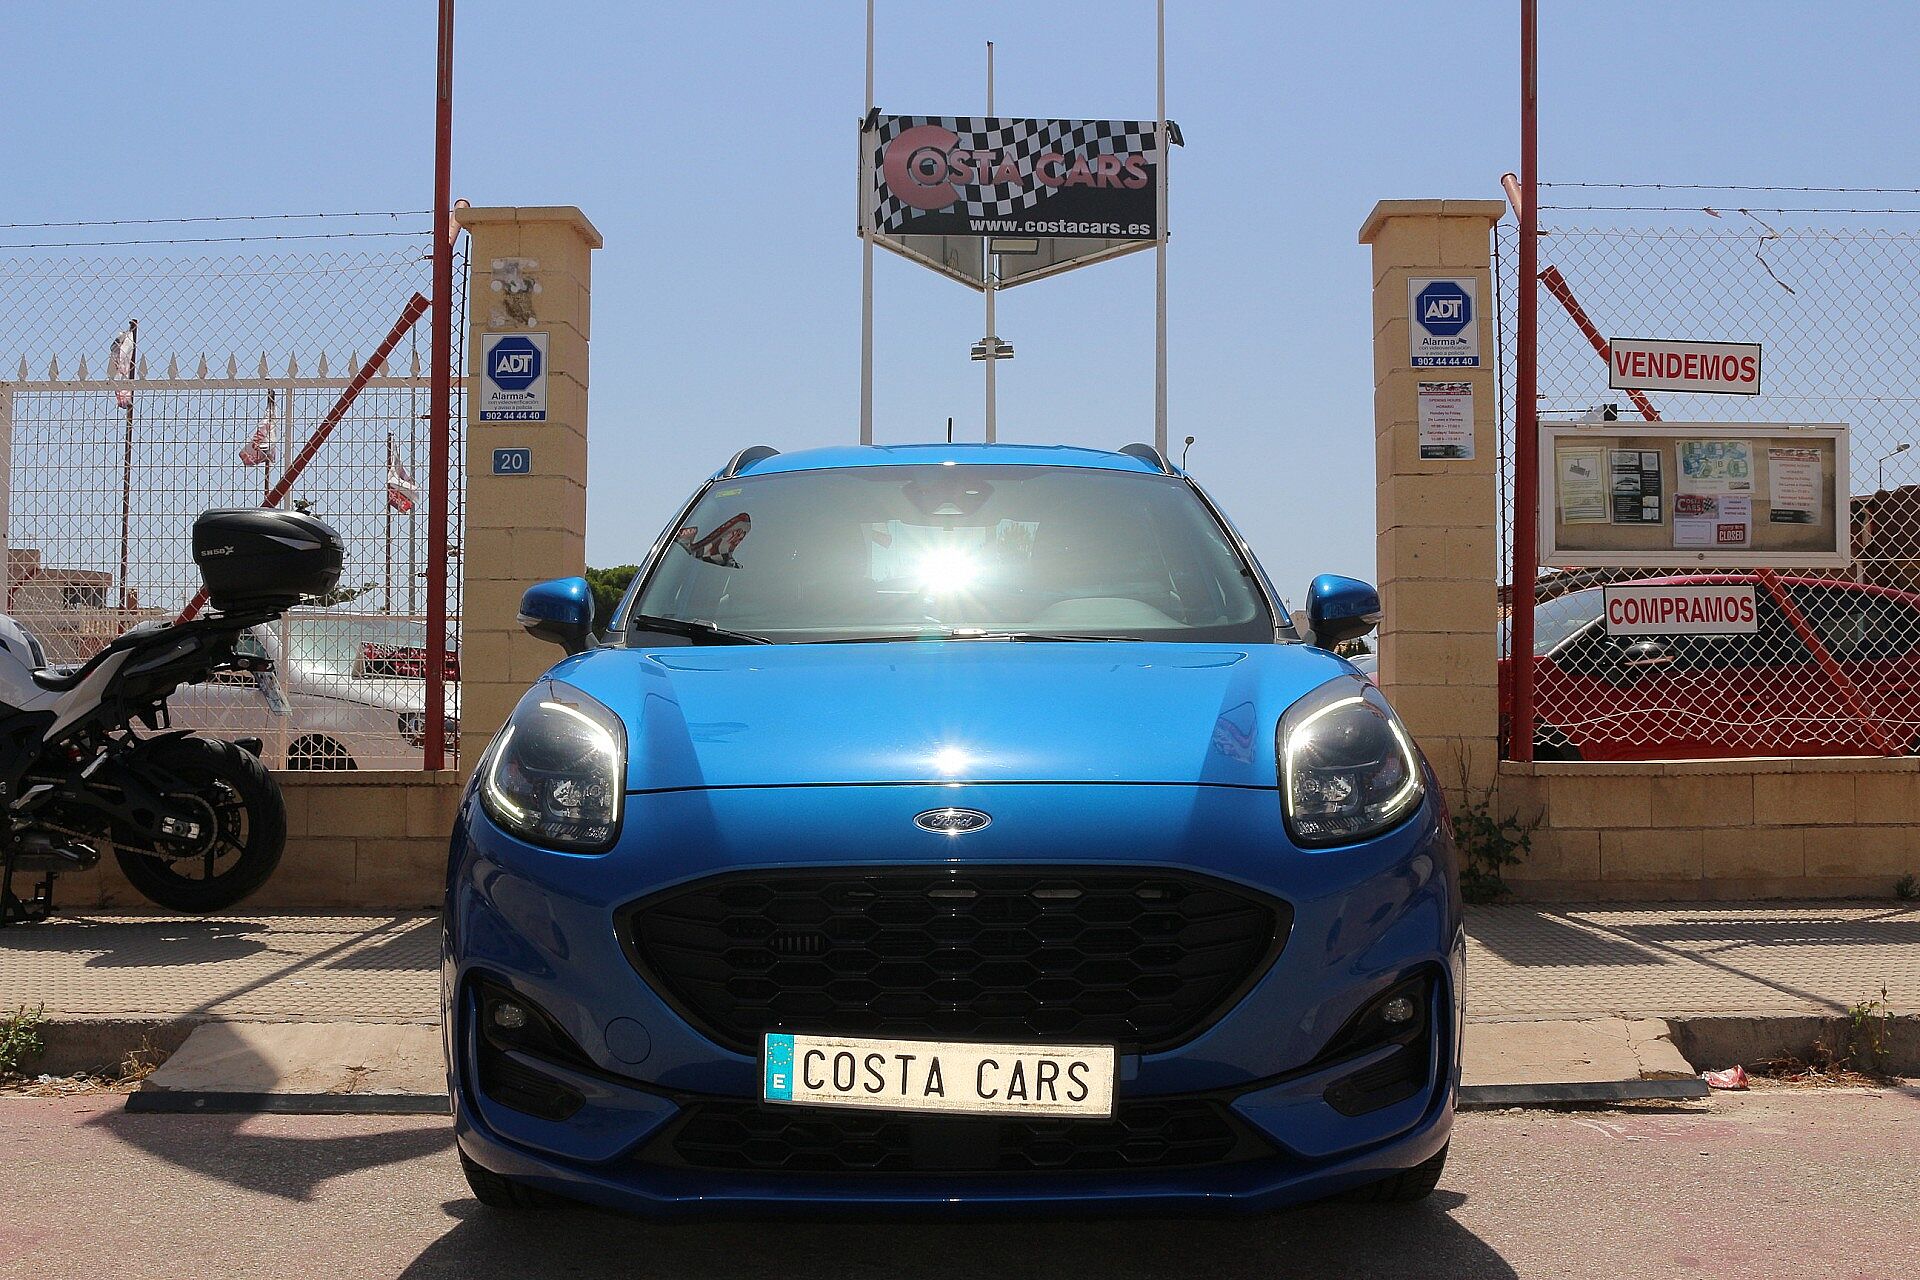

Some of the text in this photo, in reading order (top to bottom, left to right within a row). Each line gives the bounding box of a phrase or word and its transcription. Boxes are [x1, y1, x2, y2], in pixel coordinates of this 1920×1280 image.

[883, 125, 1149, 210] COSTA CARS
[969, 218, 1151, 235] www.costacars.es
[1425, 300, 1462, 318] ADT
[1422, 338, 1455, 346] Alarma
[495, 354, 533, 373] ADT
[1417, 357, 1473, 366] 902 44 44 40
[1614, 350, 1757, 383] VENDEMOS
[491, 392, 524, 400] Alarma
[486, 412, 540, 420] 902 44 44 40
[500, 453, 523, 470] 20
[1719, 530, 1744, 541] CLOSED
[1608, 596, 1754, 625] COMPRAMOS
[931, 812, 973, 828] Ford
[772, 1050, 1090, 1102] E COSTA CARS
